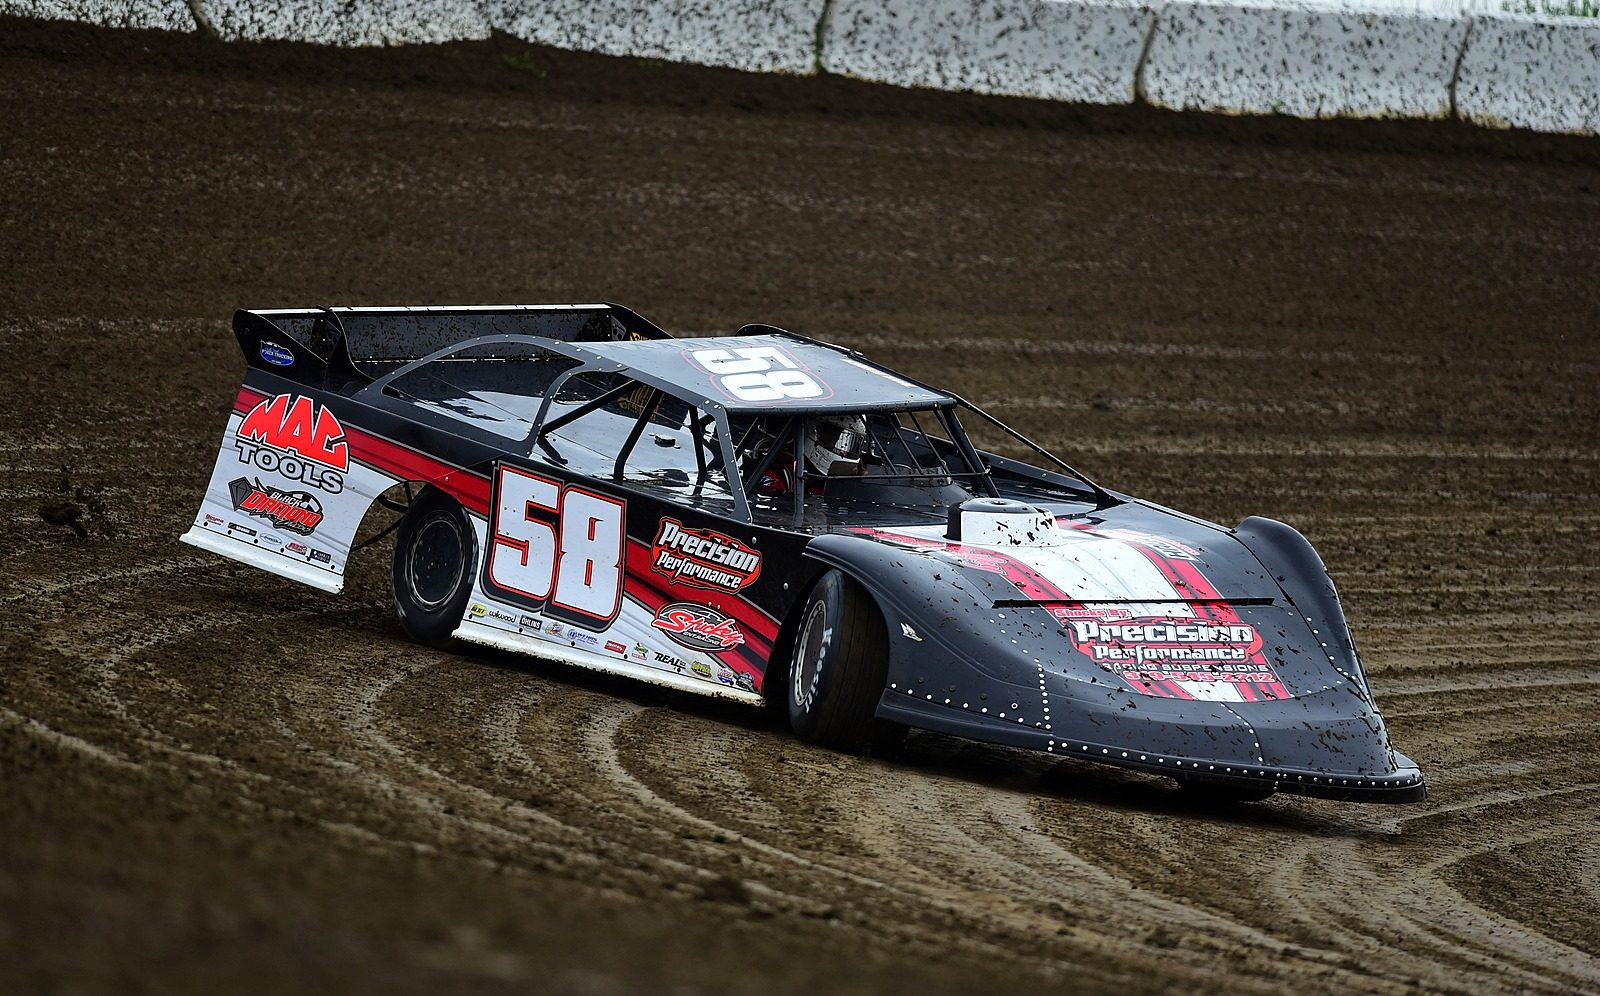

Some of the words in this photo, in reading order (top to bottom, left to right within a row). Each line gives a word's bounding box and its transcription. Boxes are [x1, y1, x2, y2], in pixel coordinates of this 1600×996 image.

[692, 346, 824, 402] 58
[236, 393, 349, 473] MAC
[236, 441, 344, 494] TOOLS
[239, 489, 321, 527] DIAMOND
[270, 491, 302, 508] BLACK
[490, 466, 624, 618] 58
[658, 521, 760, 573] Precision
[656, 550, 742, 589] Performance
[1053, 609, 1107, 619] Shocks
[1067, 620, 1254, 643] Precision
[654, 651, 684, 668] REAL
[1092, 645, 1246, 665] Performance
[1102, 662, 1157, 675] RACING
